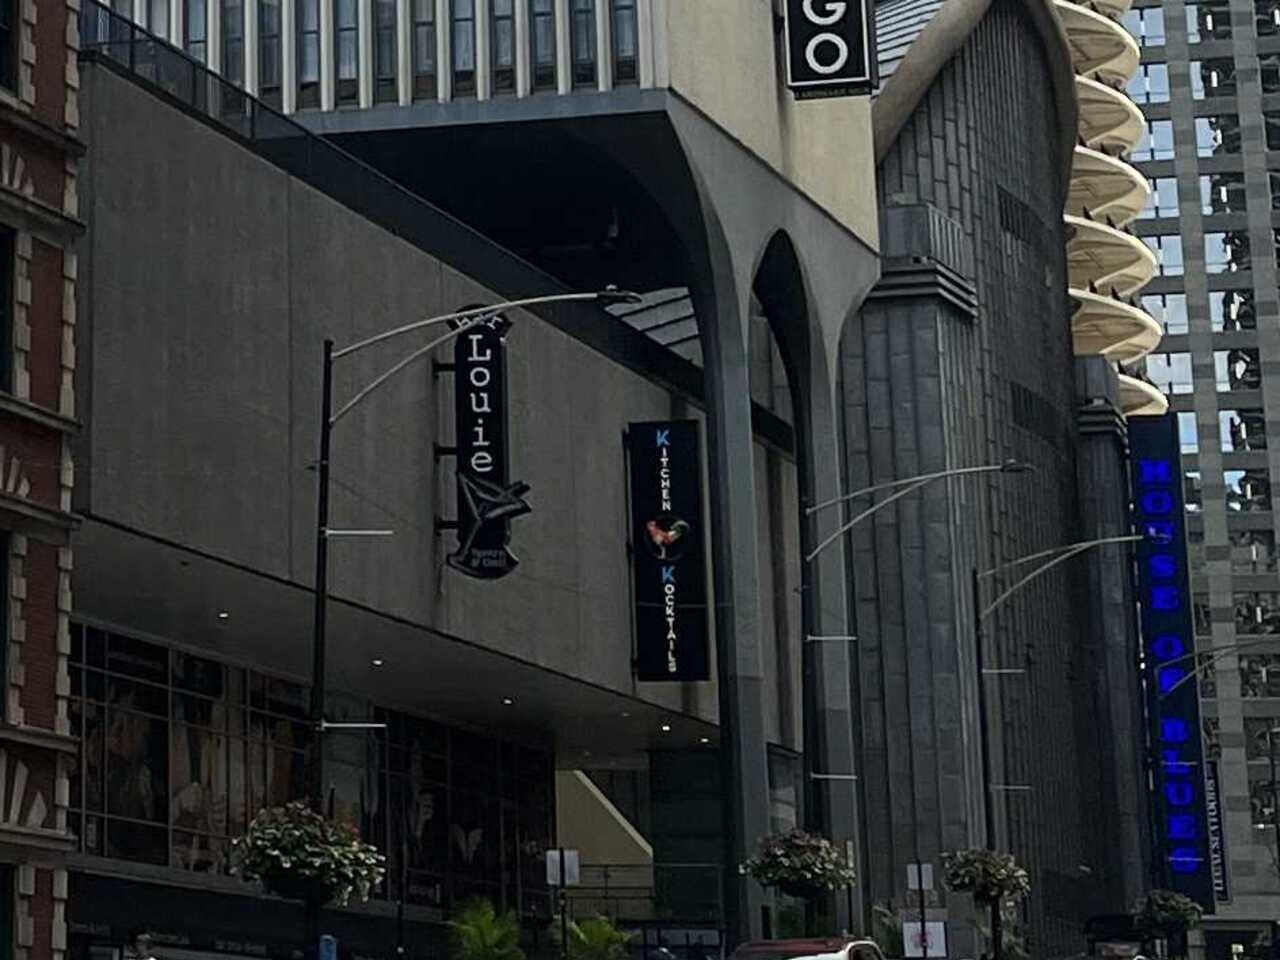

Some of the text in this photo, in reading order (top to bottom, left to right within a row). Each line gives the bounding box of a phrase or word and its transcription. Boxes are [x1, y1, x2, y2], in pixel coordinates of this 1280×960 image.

[802, 0, 848, 75] GO
[468, 333, 494, 473] Louie
[656, 429, 671, 511] KITCHEN
[661, 566, 678, 673] KOCKTAILS
